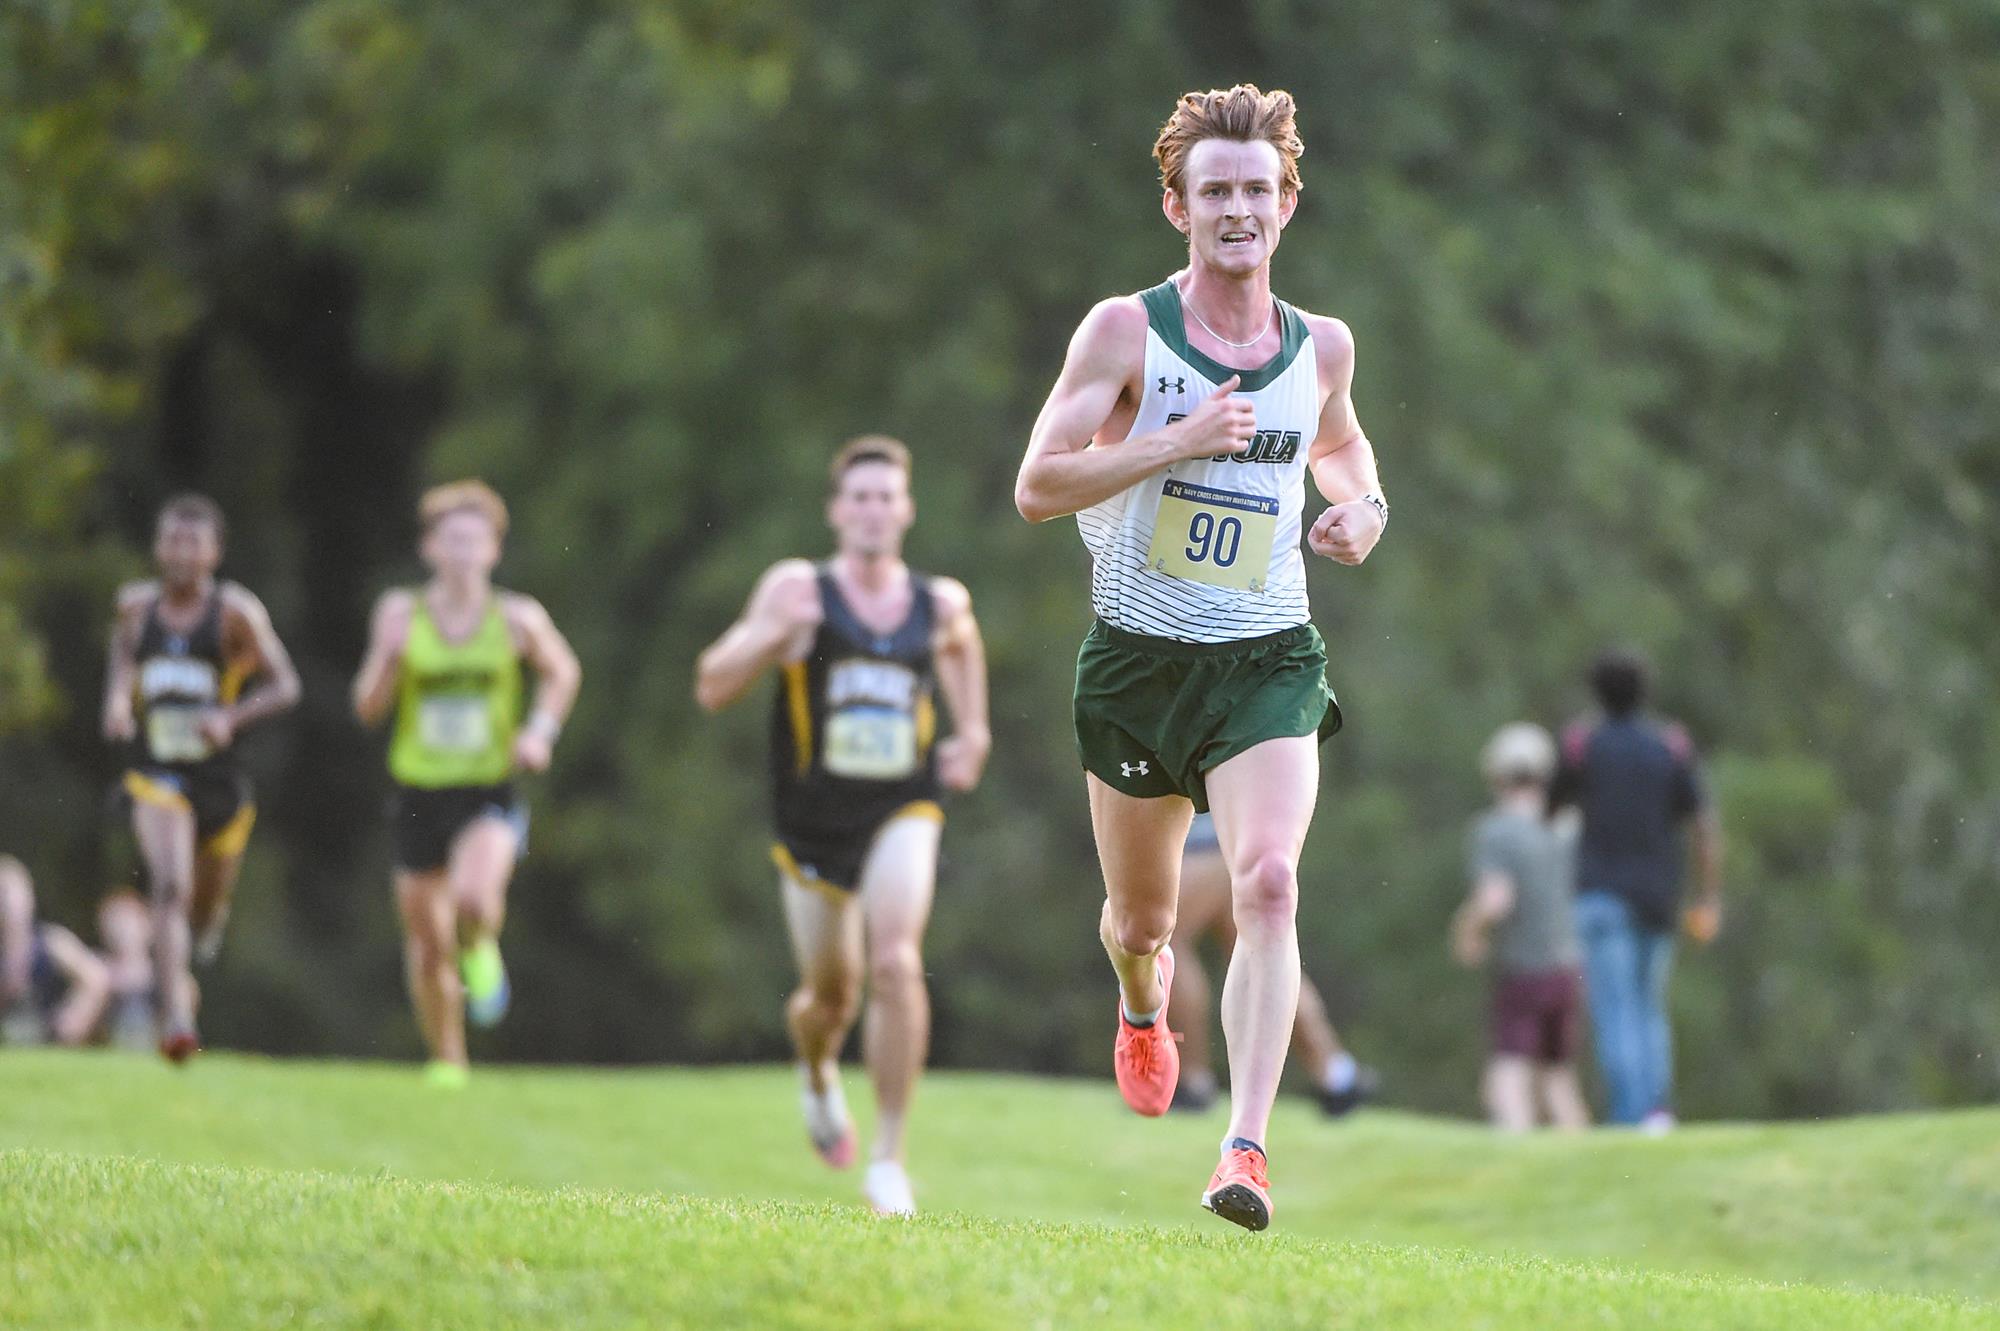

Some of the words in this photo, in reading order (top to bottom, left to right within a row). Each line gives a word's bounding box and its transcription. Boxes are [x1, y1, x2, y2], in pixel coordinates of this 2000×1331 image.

[1172, 485, 1182, 496] N
[1184, 488, 1197, 497] NAVY
[1197, 491, 1212, 499] CROSS
[1212, 494, 1232, 503] COUNTRY
[1261, 502, 1270, 512] N
[1185, 512, 1242, 568] 90
